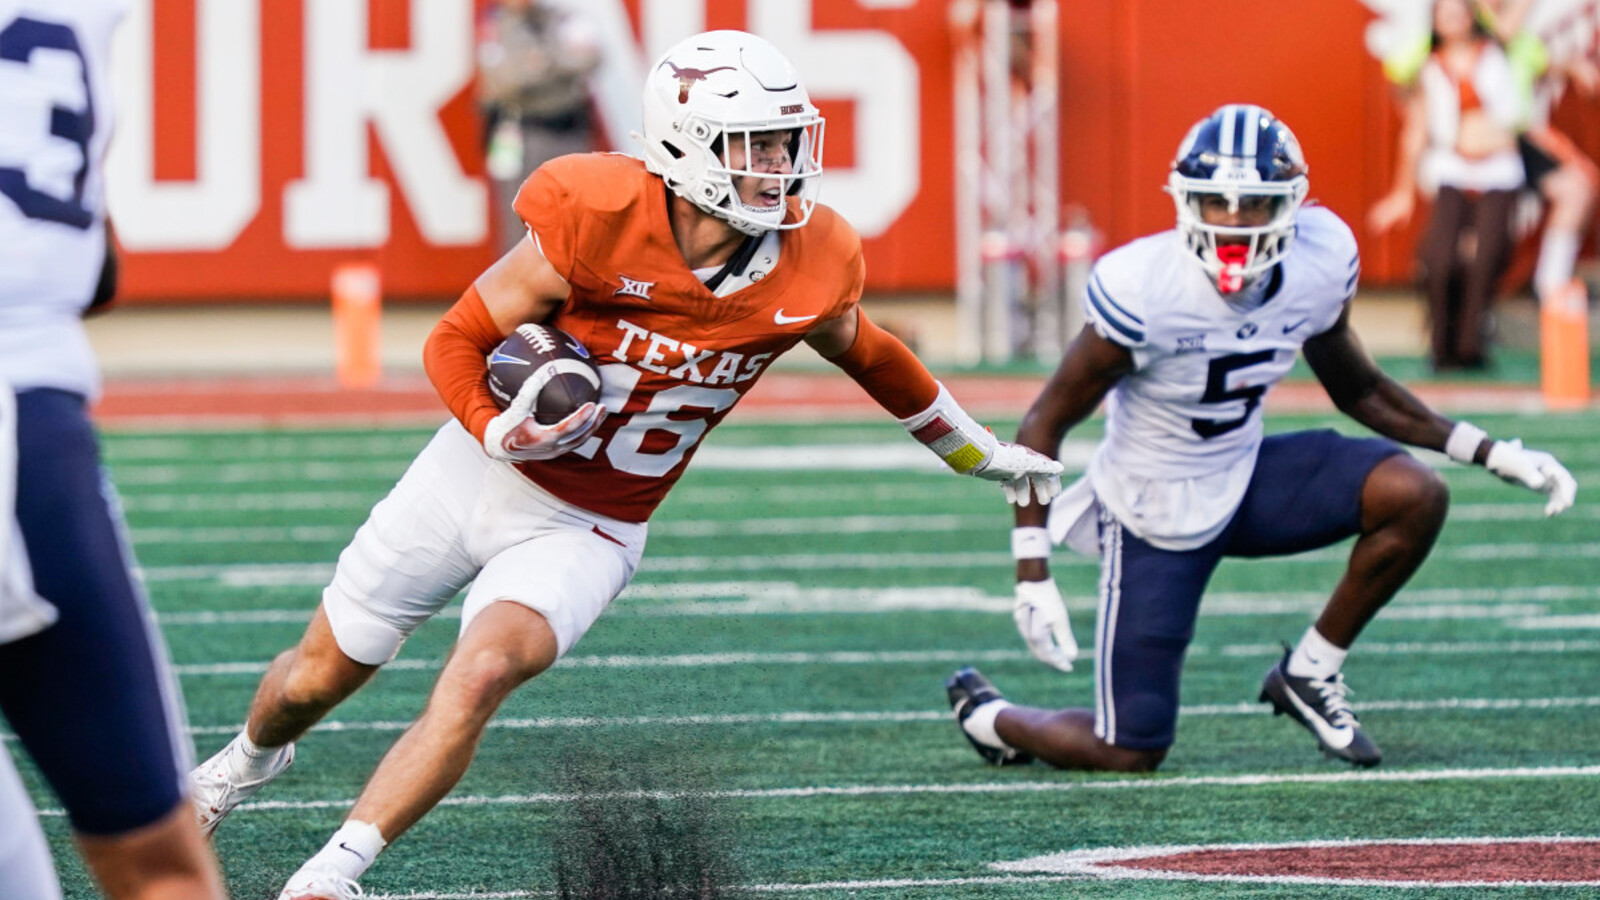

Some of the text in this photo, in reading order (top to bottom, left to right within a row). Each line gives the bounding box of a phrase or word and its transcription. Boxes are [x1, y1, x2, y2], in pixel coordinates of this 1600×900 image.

[616, 276, 655, 300] XII
[611, 319, 773, 384] TEXAS
[1190, 349, 1277, 440] 5
